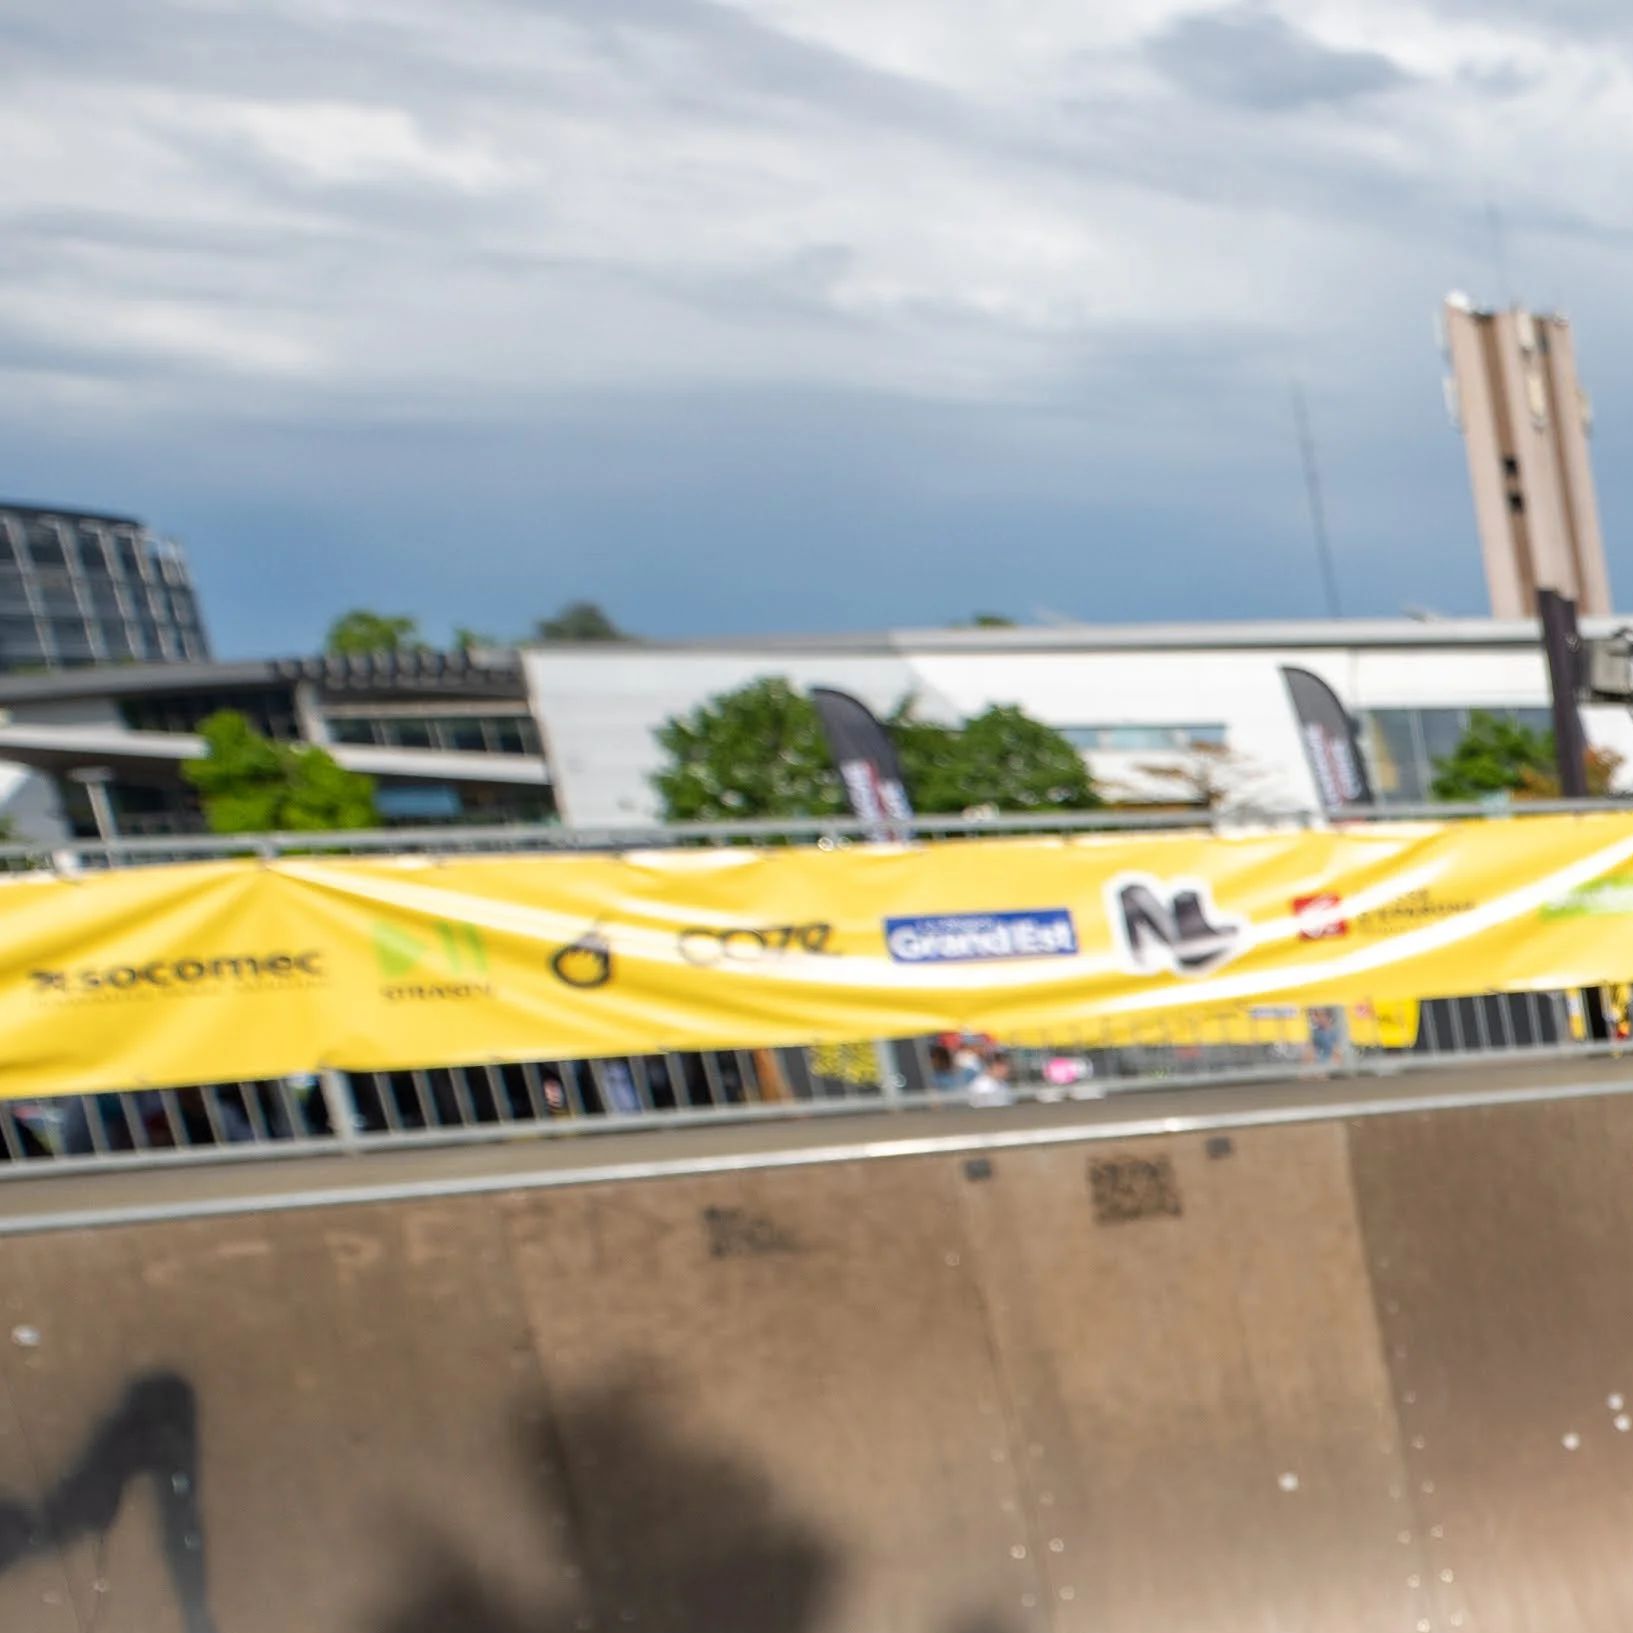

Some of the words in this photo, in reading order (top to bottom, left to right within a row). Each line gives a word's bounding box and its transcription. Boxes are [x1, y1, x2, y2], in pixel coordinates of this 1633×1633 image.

[889, 921, 1010, 960] Grand
[1011, 916, 1077, 955] Est
[80, 949, 324, 991] socomec
